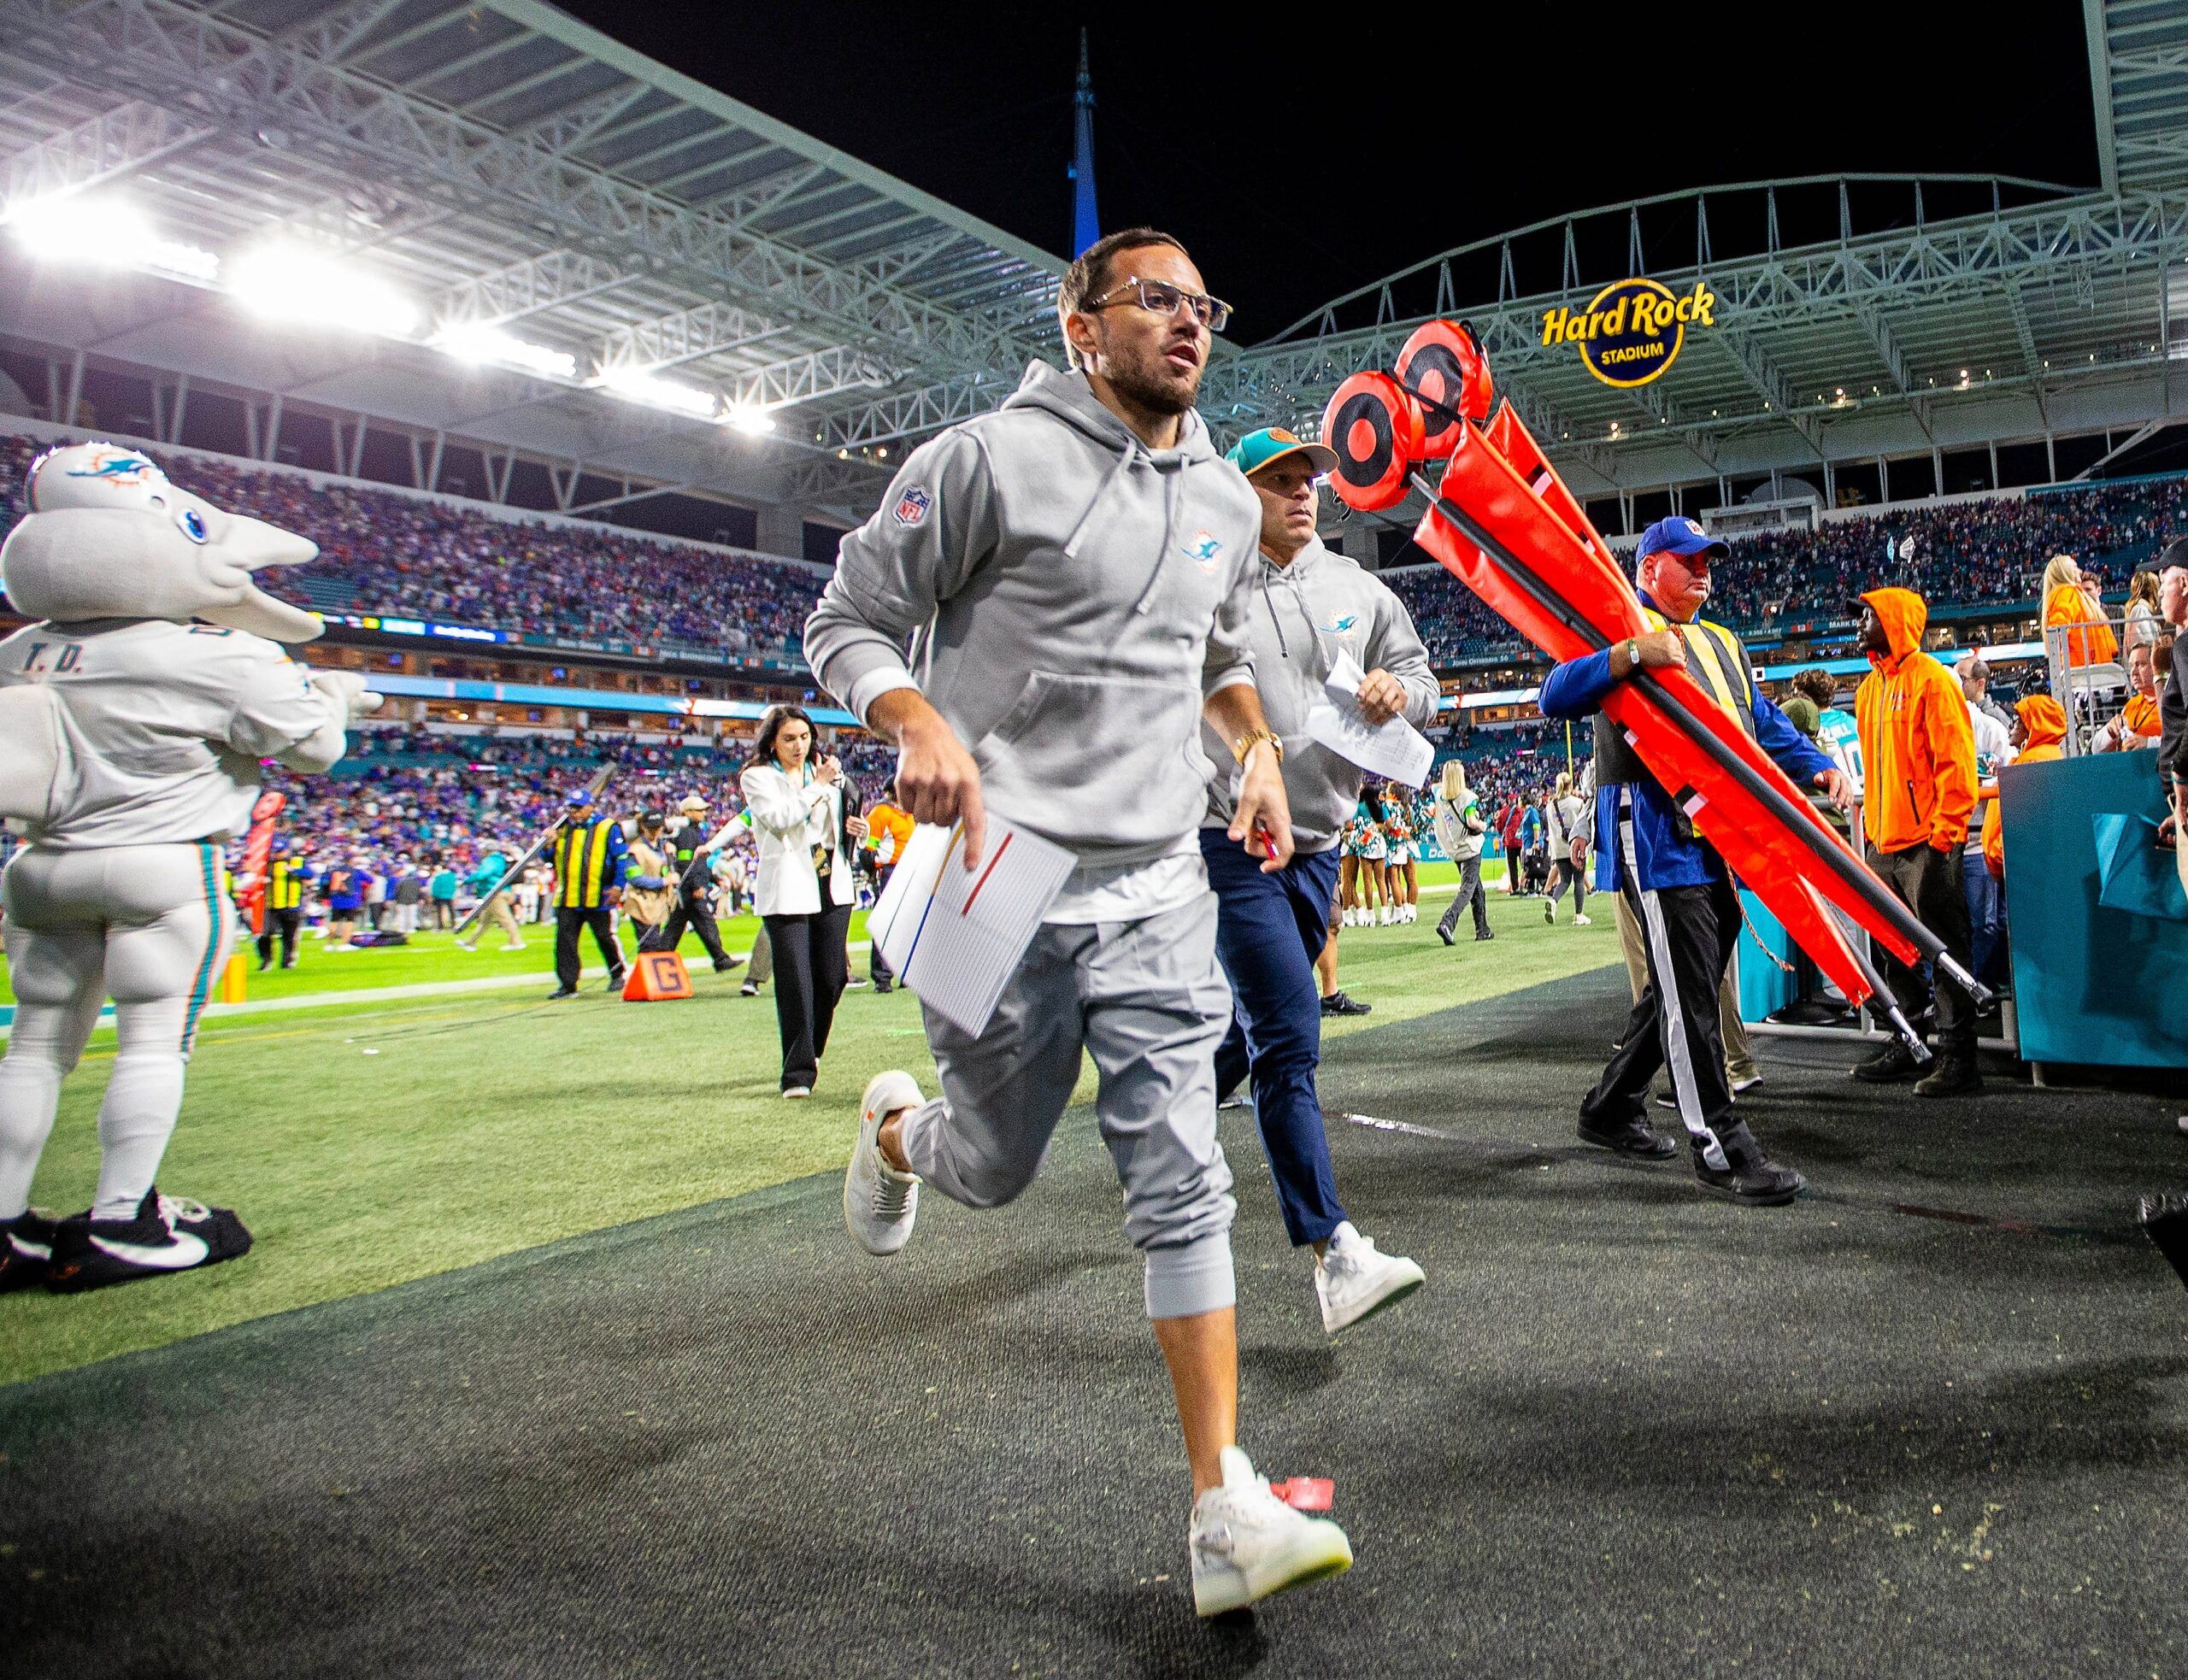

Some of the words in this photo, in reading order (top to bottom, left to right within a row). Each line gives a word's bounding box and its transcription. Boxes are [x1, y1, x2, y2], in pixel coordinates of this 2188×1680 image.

[1541, 296, 1629, 346] Hard
[1631, 282, 1715, 337] Rock
[1601, 342, 1664, 365] STADIUM
[899, 501, 920, 520] NFL
[23, 643, 48, 672] T.
[54, 643, 83, 673] D.
[652, 957, 683, 991] G
